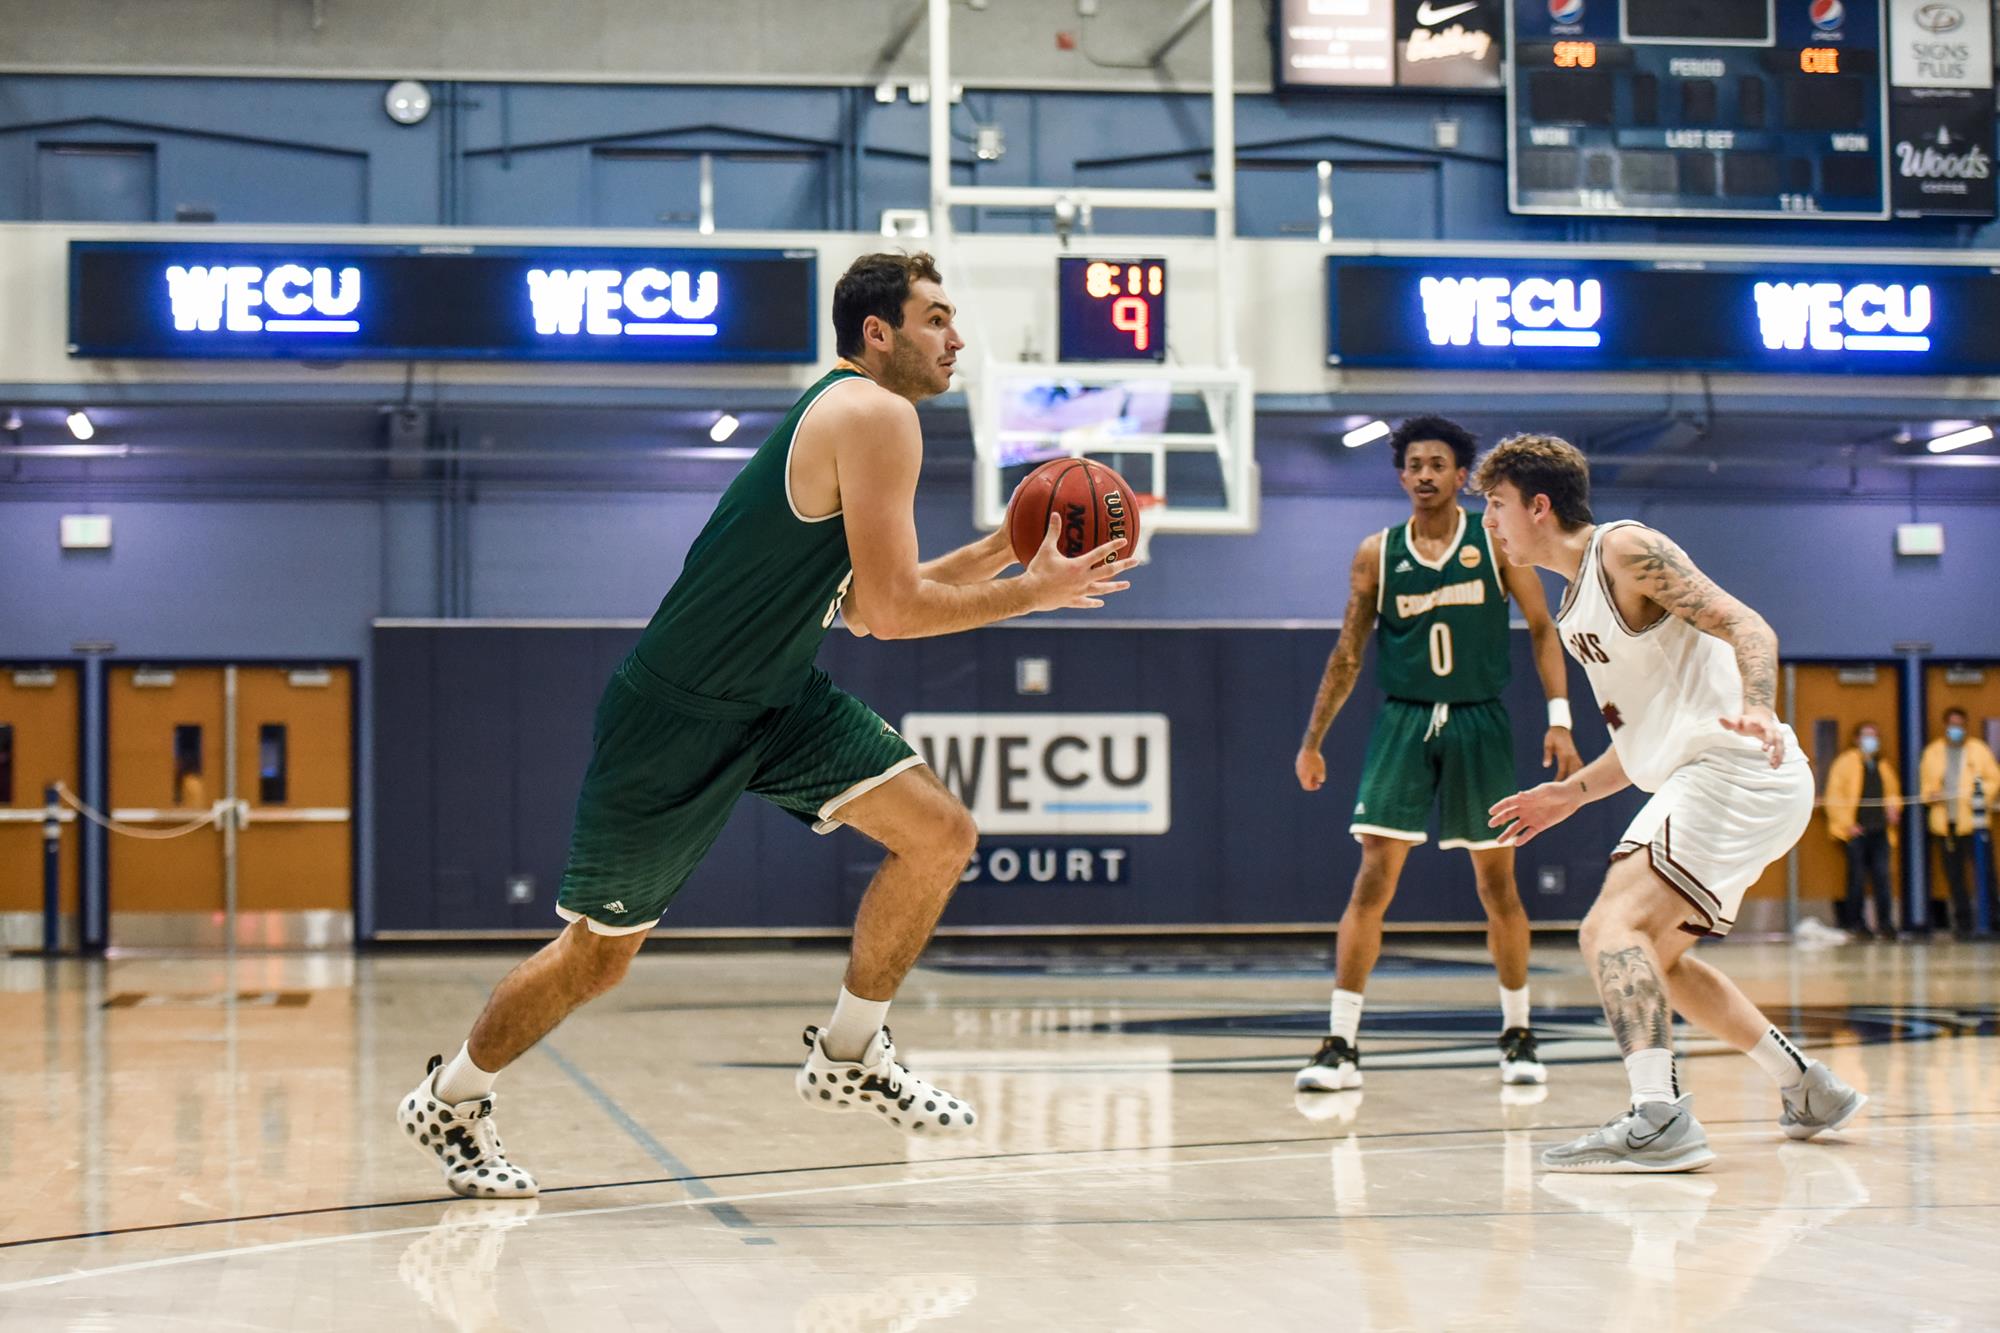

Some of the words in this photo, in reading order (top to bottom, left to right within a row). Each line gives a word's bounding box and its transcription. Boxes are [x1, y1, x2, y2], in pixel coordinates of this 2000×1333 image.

[1553, 41, 1596, 68] SPU
[1670, 57, 1725, 77] PERIOD
[1912, 43, 1969, 61] SIGNS
[1918, 62, 1965, 79] PLUS
[1665, 130, 1703, 148] LAST
[1705, 131, 1734, 149] SET
[1896, 141, 1989, 178] Woods
[166, 265, 361, 332] WECU
[527, 268, 718, 335] WECU
[1112, 297, 1149, 350] 9
[1420, 277, 1601, 346] WECU
[1754, 281, 1931, 351] WECU
[1429, 622, 1453, 676] 0
[920, 735, 1147, 812] WECU
